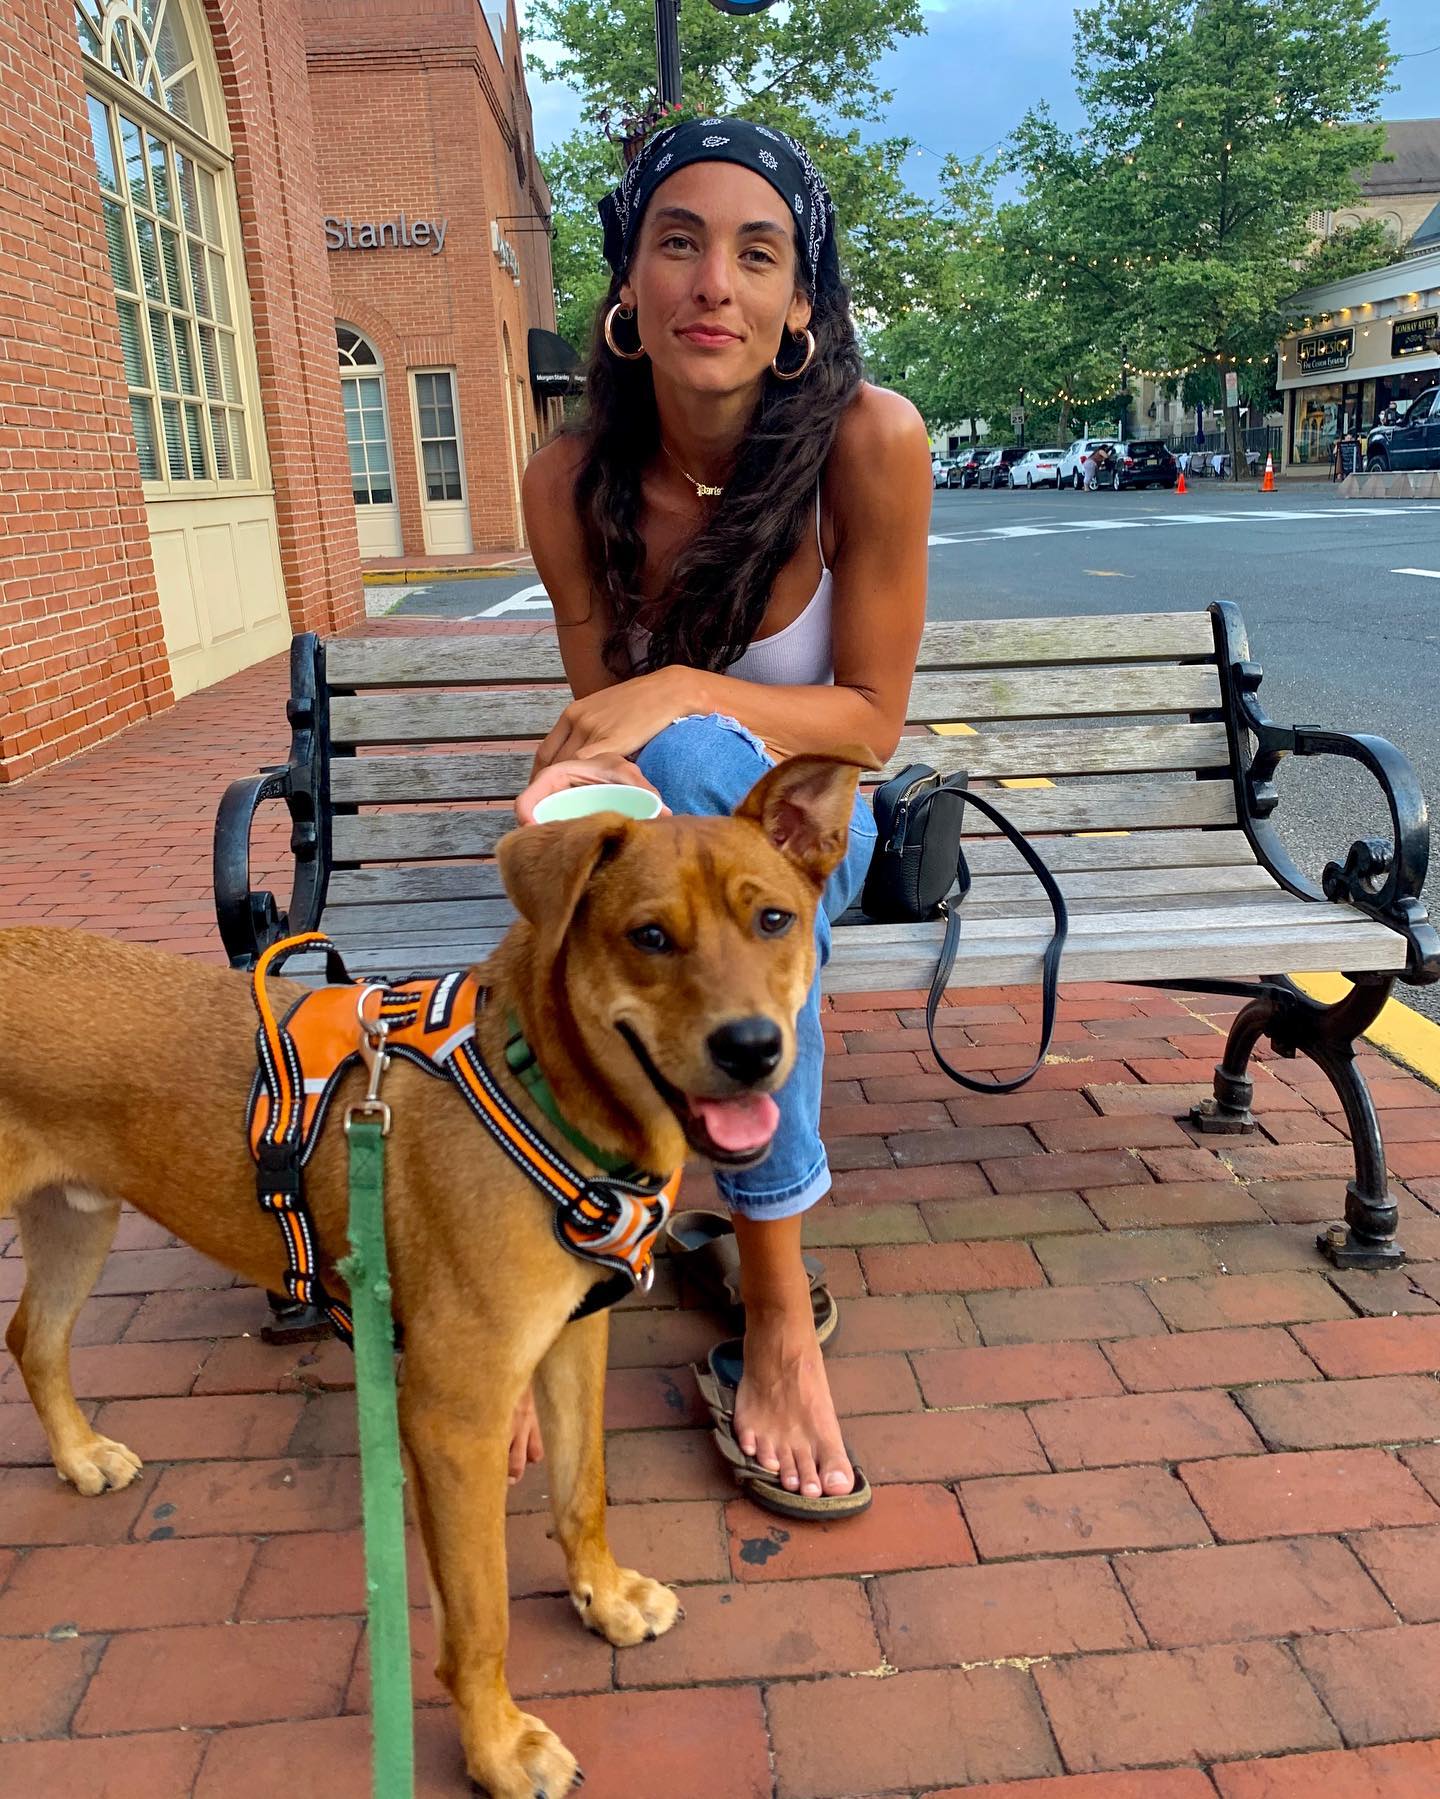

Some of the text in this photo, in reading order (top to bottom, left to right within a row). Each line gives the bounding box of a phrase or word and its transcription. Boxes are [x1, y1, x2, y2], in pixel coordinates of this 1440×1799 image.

[324, 212, 448, 256] Stanley
[536, 374, 554, 382] Morgan
[554, 374, 570, 382] Stanley
[1012, 415, 1023, 424] 25
